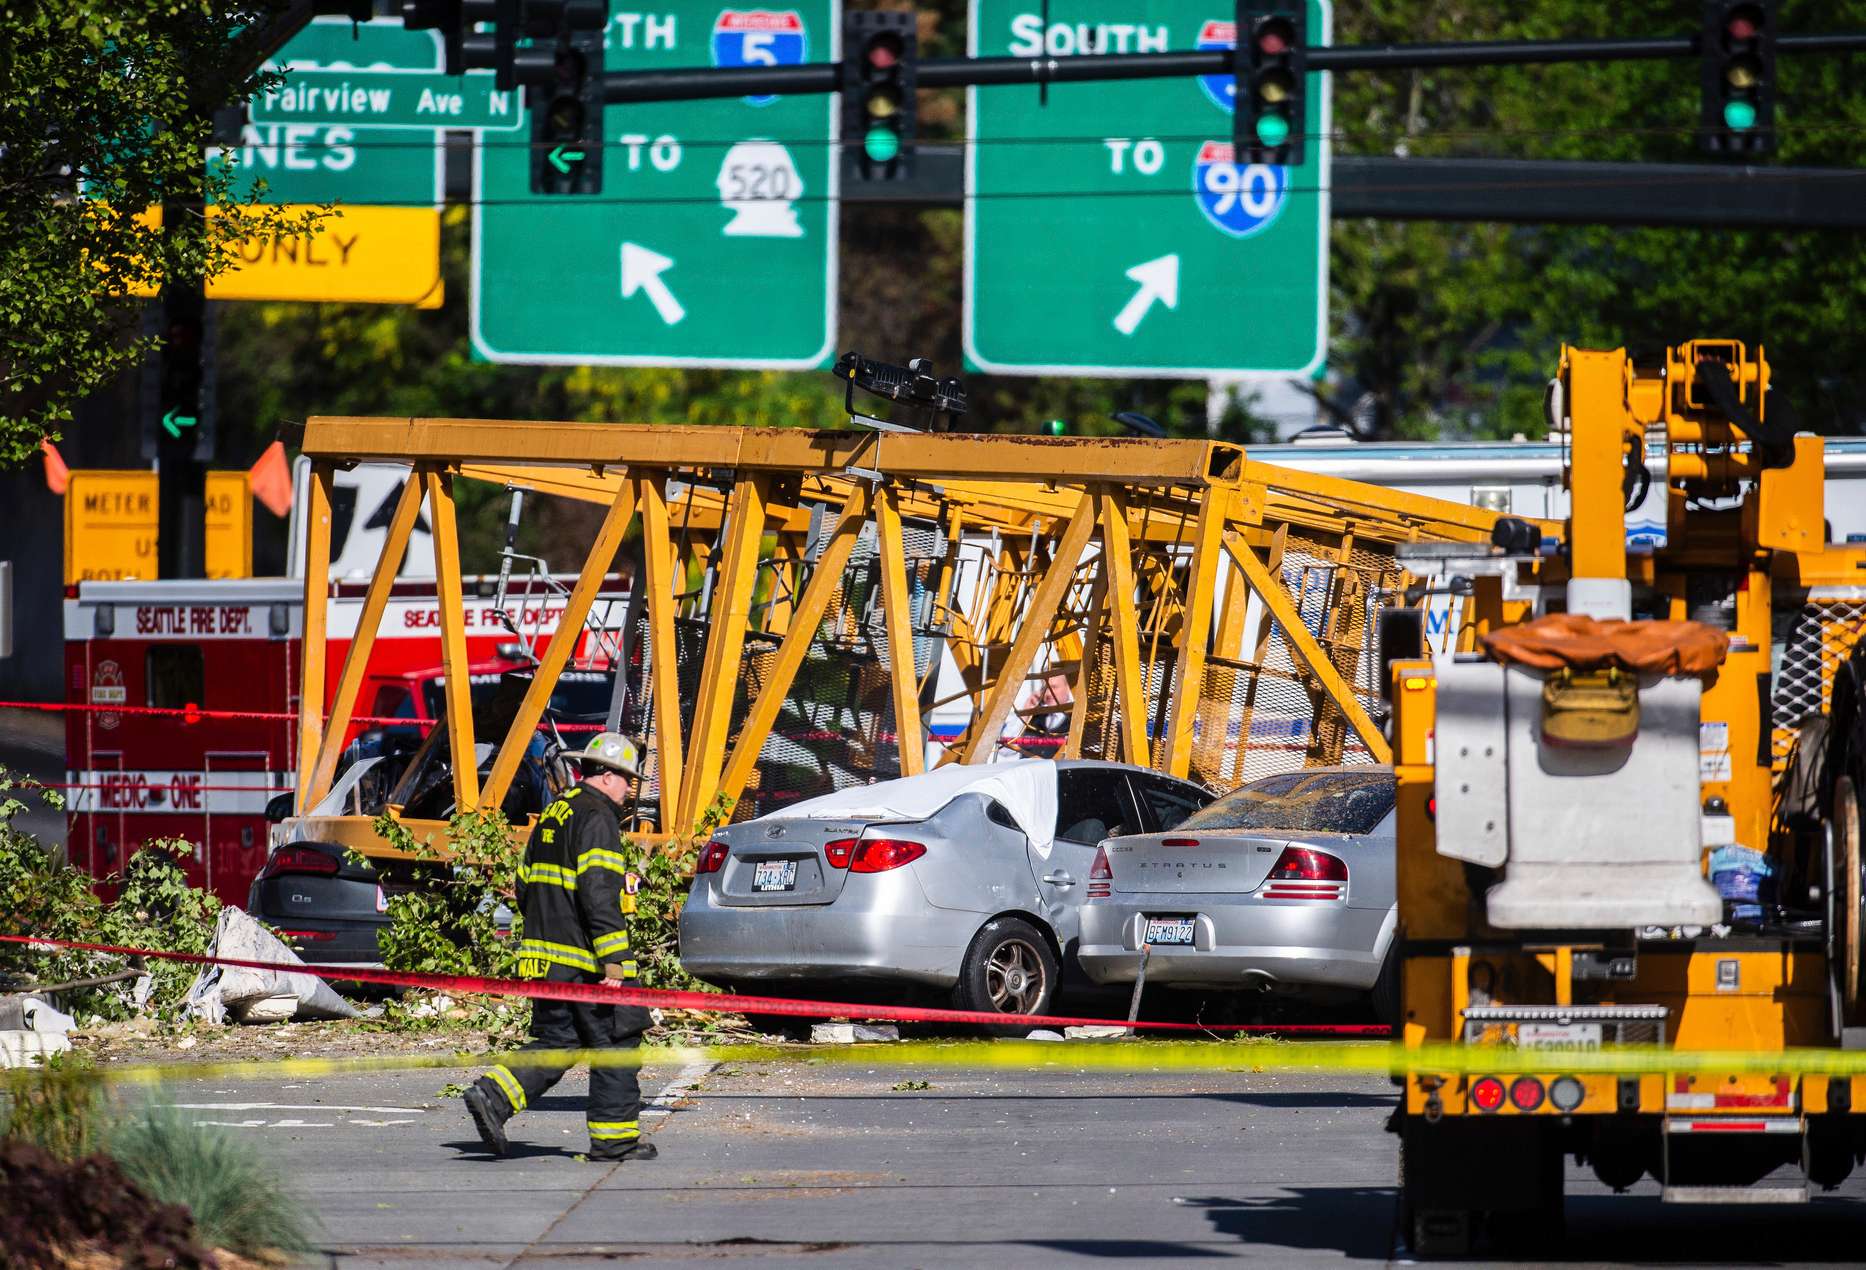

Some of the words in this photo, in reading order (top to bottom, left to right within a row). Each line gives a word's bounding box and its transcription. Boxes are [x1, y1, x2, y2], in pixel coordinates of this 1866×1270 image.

[603, 13, 676, 49] TH
[1008, 14, 1168, 57] SOUTH
[265, 82, 391, 113] Fairview
[416, 88, 463, 115] Ave
[489, 91, 509, 115] N
[620, 134, 683, 172] TO
[1105, 137, 1165, 174] TO
[729, 165, 789, 199] 520
[1203, 163, 1277, 218] 90
[239, 231, 359, 266] ONLY
[84, 493, 151, 514] METER
[136, 607, 186, 634] SEATTLE
[190, 607, 216, 634] FIRE
[404, 610, 475, 628] SEAE
[100, 774, 147, 809] MEDIC
[170, 774, 202, 809] ONE
